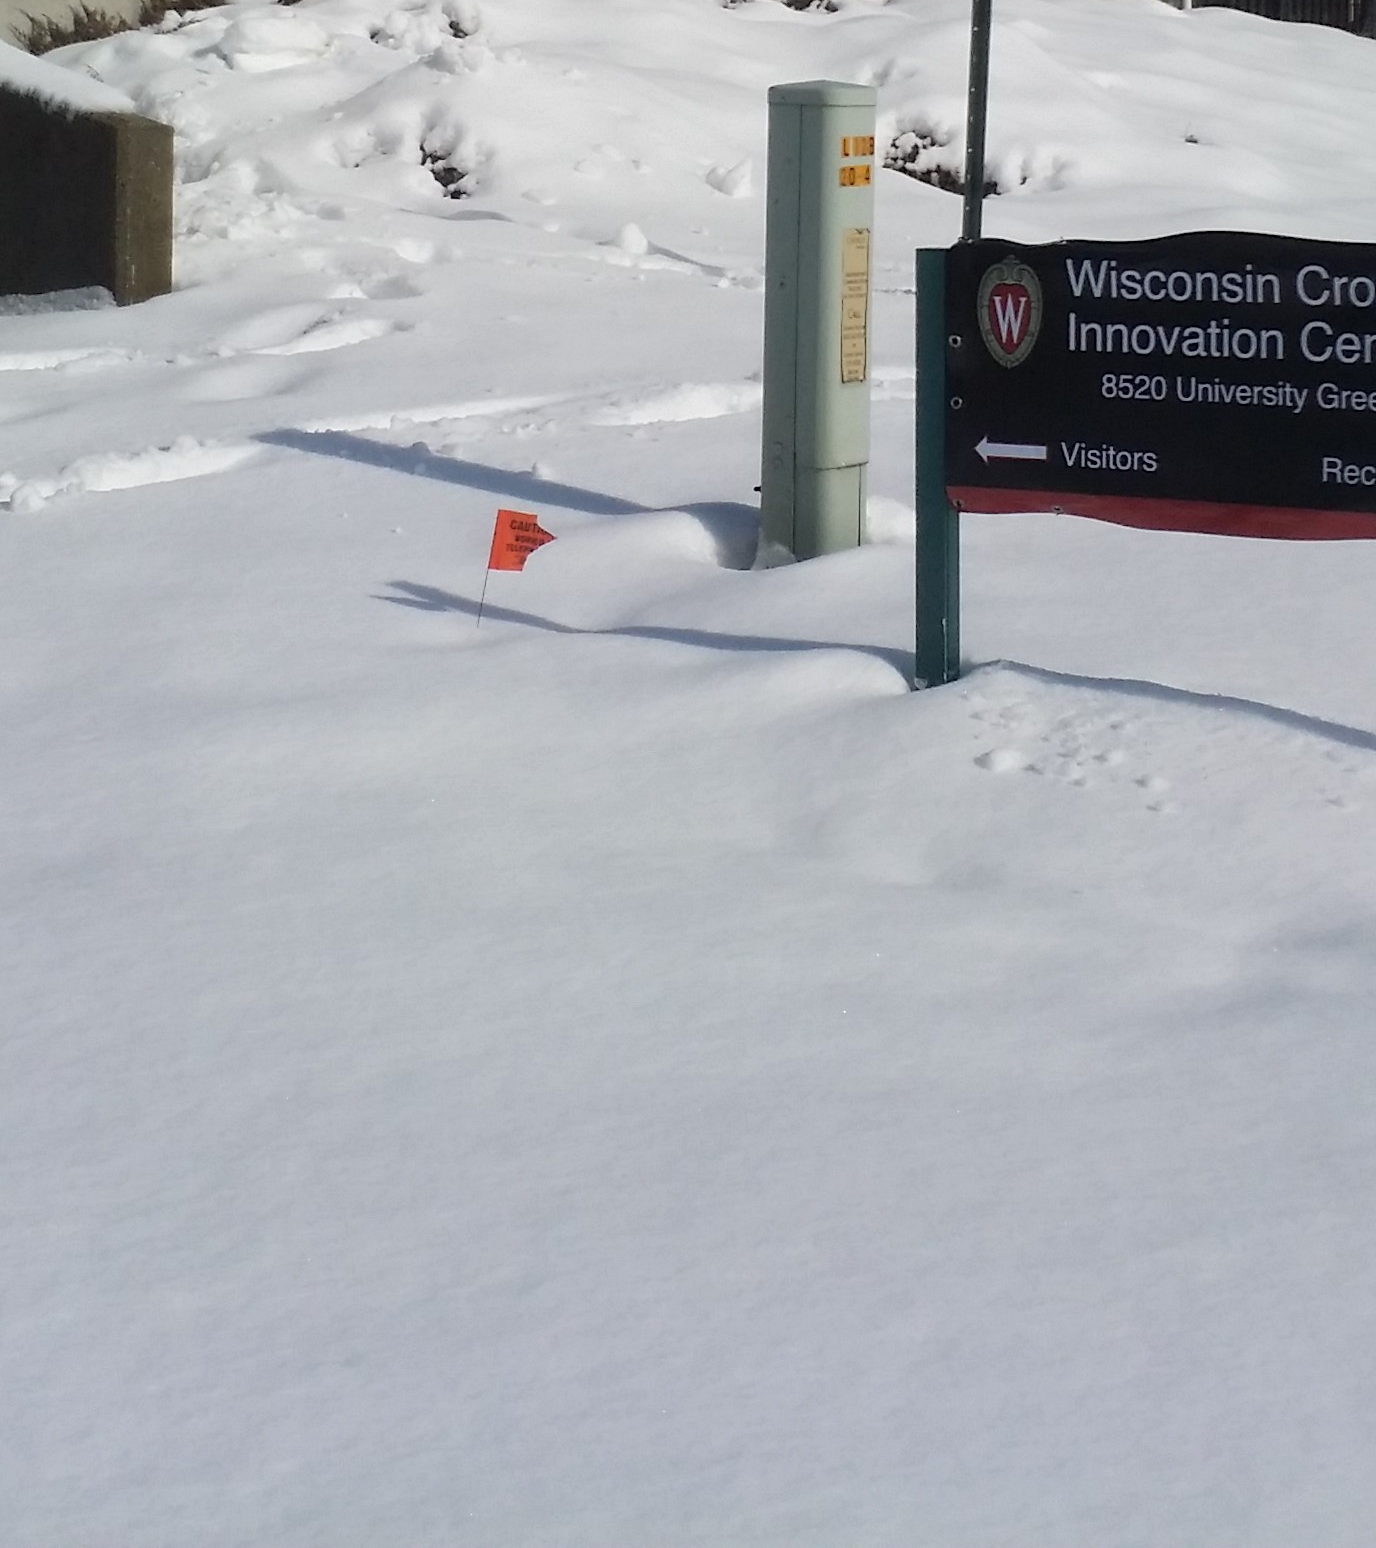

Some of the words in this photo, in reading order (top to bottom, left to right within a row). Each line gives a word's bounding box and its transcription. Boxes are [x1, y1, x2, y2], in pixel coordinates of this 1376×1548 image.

[1065, 258, 1282, 304] Wisconsin
[993, 293, 1028, 344] W
[1066, 312, 1285, 359] Innovation
[1101, 374, 1168, 401] 8520
[1176, 377, 1309, 414] University
[1061, 442, 1159, 472] Visitors
